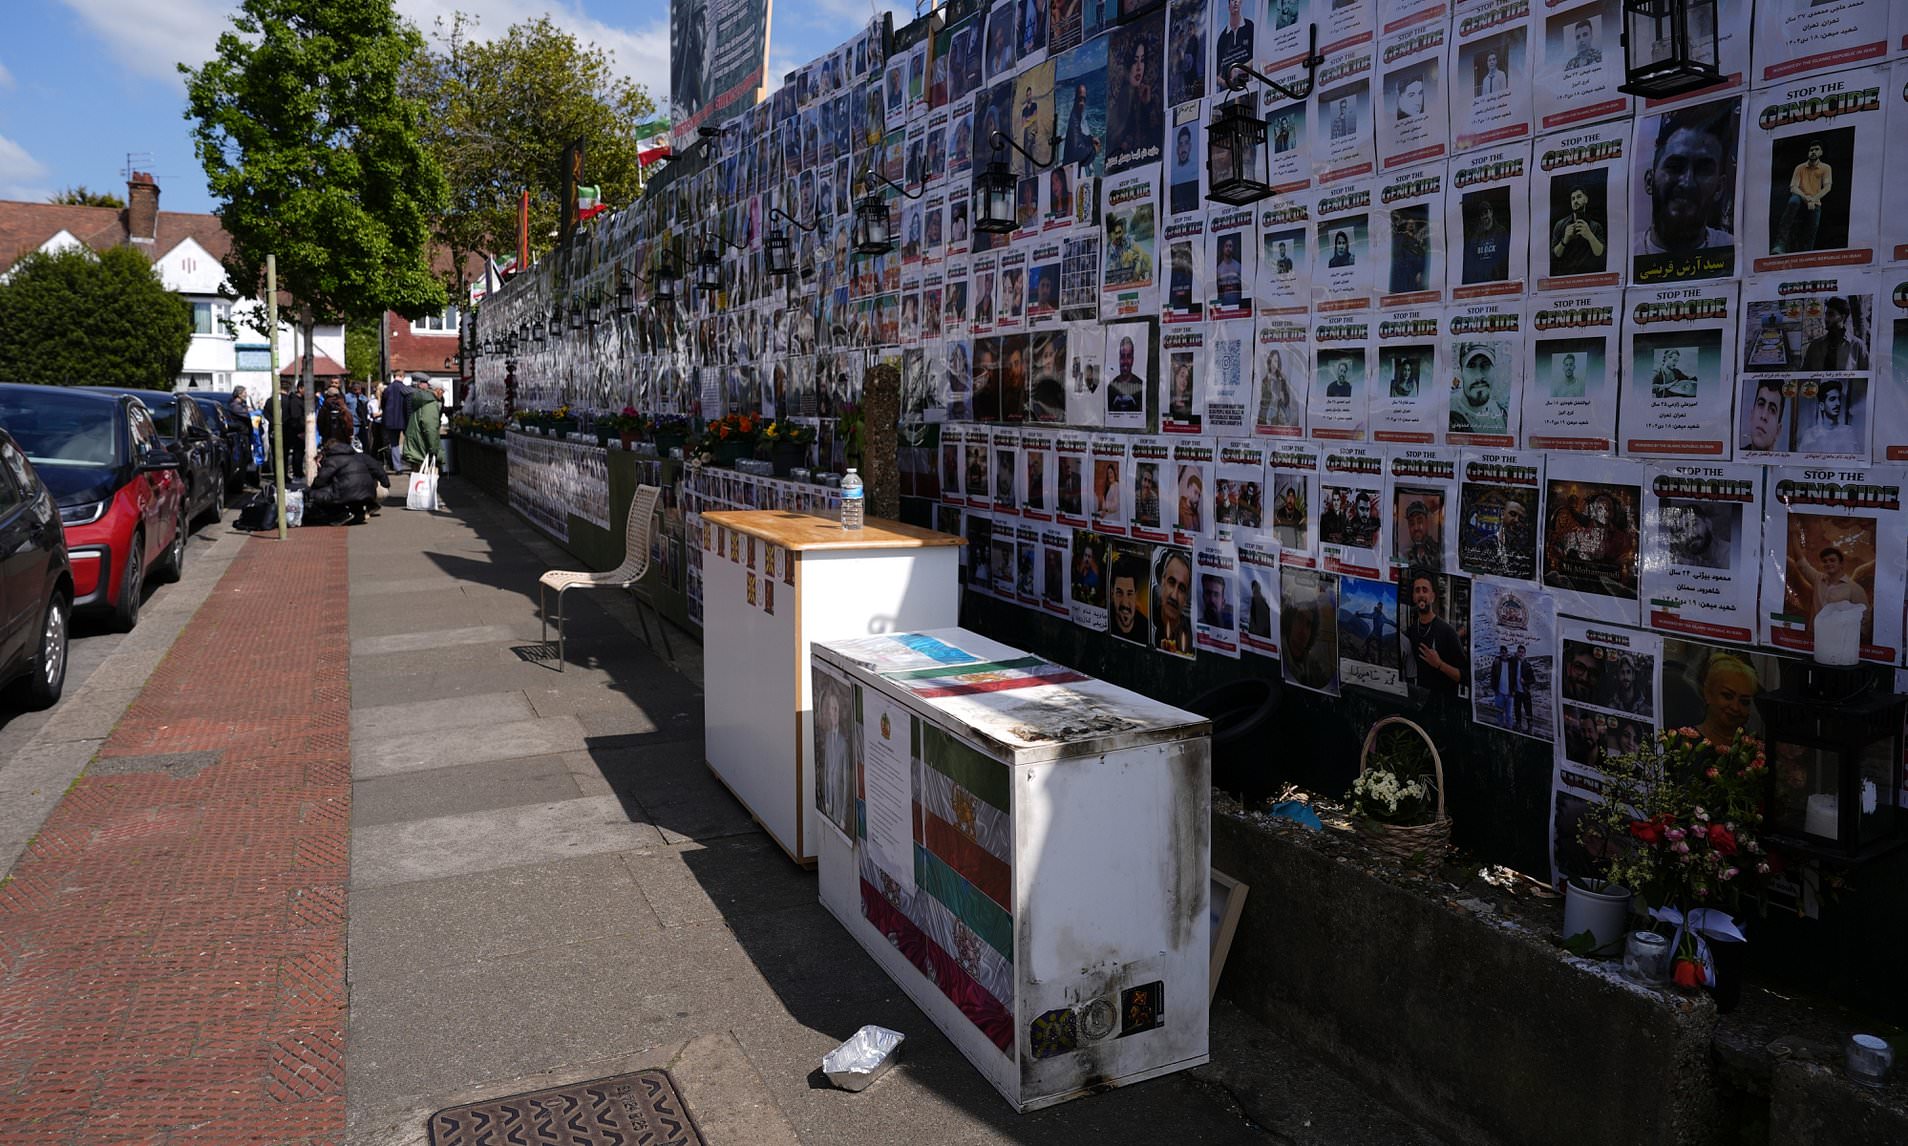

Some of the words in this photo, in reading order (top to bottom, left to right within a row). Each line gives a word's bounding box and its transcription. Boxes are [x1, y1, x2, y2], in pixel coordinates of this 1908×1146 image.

[1476, 1, 1493, 13] STOP
[1830, 5, 1846, 14] حاجی
[1460, 0, 1530, 37] GENOCIDE
[1785, 16, 1797, 24] سال
[1398, 31, 1413, 41] STOP
[1413, 27, 1426, 36] THE
[1802, 22, 1819, 32] تهران
[1840, 26, 1858, 34] شهید
[1383, 28, 1444, 64] GENOCIDE
[1812, 55, 1832, 64] ISLAMIC
[1319, 54, 1371, 87] GENOCIDE
[1786, 86, 1816, 101] STOP
[1818, 81, 1845, 94] THE
[1759, 86, 1881, 130] GENOCIDE
[1561, 137, 1581, 147] STOP
[1583, 133, 1600, 144] THE
[1471, 156, 1488, 167] STOP
[1489, 153, 1504, 163] THE
[1541, 138, 1623, 171] GENOCIDE
[1395, 172, 1410, 183] STOP
[1411, 171, 1424, 180] THE
[1454, 158, 1524, 189] GENOCIDE
[1330, 188, 1343, 196] STOP
[1344, 185, 1355, 194] THE
[1381, 176, 1441, 204] GENOCIDE
[1318, 190, 1371, 216] GENOCIDE
[1639, 260, 1675, 280] قریشی
[1676, 255, 1702, 277] آرش
[1703, 257, 1725, 273] سید
[1656, 290, 1681, 300] STOP
[1682, 288, 1702, 298] THE
[1778, 279, 1838, 296] GENOCIDE
[1485, 305, 1499, 313] THE
[1553, 301, 1574, 309] STOP
[1575, 299, 1592, 307] THE
[1633, 297, 1728, 325] GENOCIDE
[1393, 312, 1409, 320] STOP
[1409, 311, 1420, 319] THE
[1534, 306, 1614, 331] GENOCIDE
[1315, 324, 1369, 340] GENOCIDE
[1378, 319, 1438, 339] GENOCIDE
[1450, 313, 1520, 335] GENOCIDE
[1422, 451, 1436, 459] THE
[1482, 455, 1500, 463] STOP
[1501, 456, 1518, 464] THE
[1325, 454, 1382, 476] GENOCIDE
[1392, 457, 1455, 479] GENOCIDE
[1676, 467, 1701, 476] STOP
[1702, 467, 1724, 476] THE
[1466, 461, 1538, 486] GENOCIDE
[1804, 470, 1836, 480] STOP
[1838, 472, 1865, 482] THE
[1653, 474, 1754, 503] GENOCIDE
[1775, 479, 1900, 511] GENOCIDE
[1668, 568, 1681, 576] سال
[1676, 583, 1696, 591] سمنان
[1718, 604, 1737, 612] شهید
